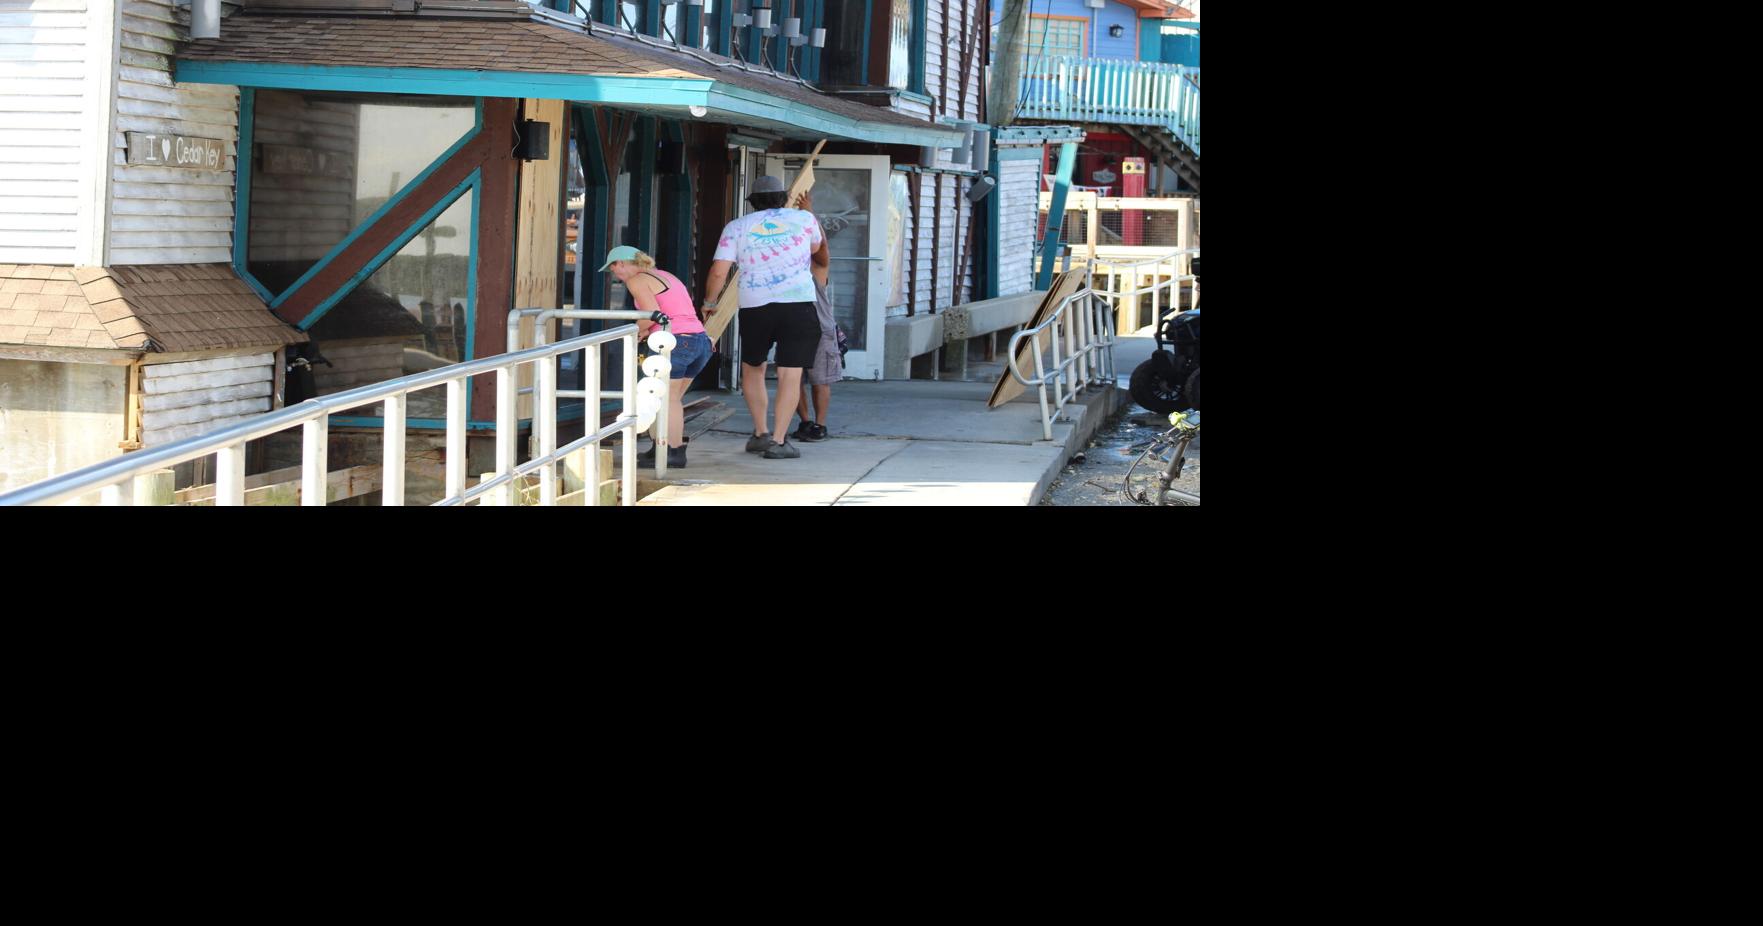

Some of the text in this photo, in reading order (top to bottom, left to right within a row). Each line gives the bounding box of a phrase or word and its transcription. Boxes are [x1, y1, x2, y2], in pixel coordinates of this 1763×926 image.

[145, 135, 220, 169] I Cedar Key
